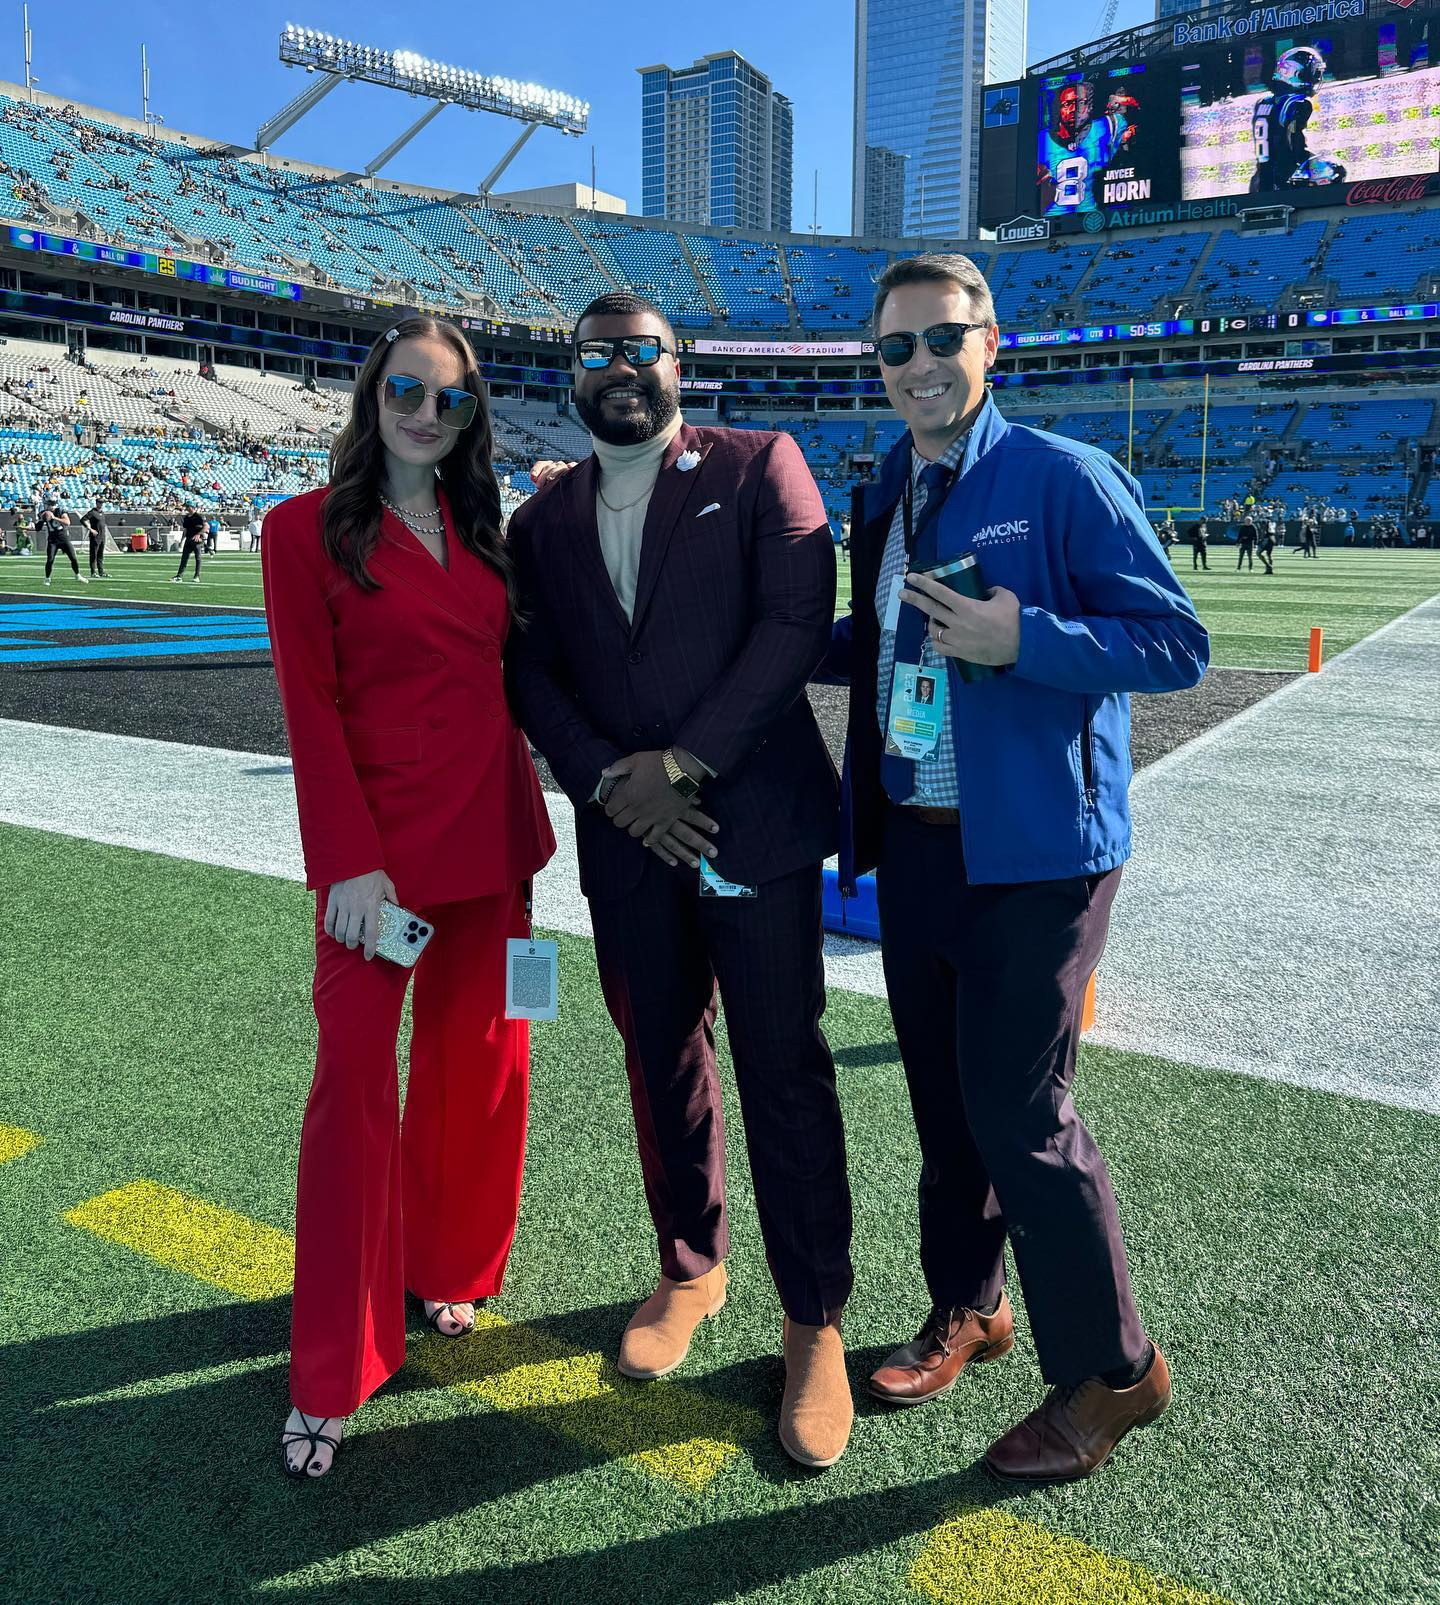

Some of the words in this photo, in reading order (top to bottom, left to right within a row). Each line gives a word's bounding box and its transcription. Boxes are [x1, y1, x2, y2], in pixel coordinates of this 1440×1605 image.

[1173, 16, 1232, 46] Bank
[1234, 13, 1260, 36] of
[1261, 0, 1365, 31] America
[1055, 156, 1088, 206] 8
[1104, 167, 1135, 181] JAYCEE
[1103, 179, 1151, 204] HORN
[1346, 175, 1431, 206] Coca-Cola
[1109, 208, 1174, 228] Atrium
[1177, 199, 1239, 220] Health
[1000, 223, 1045, 241] LOWE'S
[101, 249, 117, 260] BALL
[159, 258, 175, 275] 25
[231, 273, 250, 286] BUD
[249, 276, 276, 292] LIGHT
[109, 311, 146, 326] CAROLINA
[147, 317, 185, 331] PANTHERS
[1201, 320, 1210, 332] 0
[1288, 314, 1298, 327] 0
[1017, 336, 1037, 344] BUD
[1036, 333, 1061, 343] LIGHT
[1130, 324, 1161, 337] 50:55
[1237, 362, 1274, 371] CAROLINA
[1275, 360, 1314, 370] PANTHERS
[692, 381, 723, 390] PANTHERS
[985, 520, 1030, 539] WCNC
[976, 534, 1028, 548] CHARLOTTE
